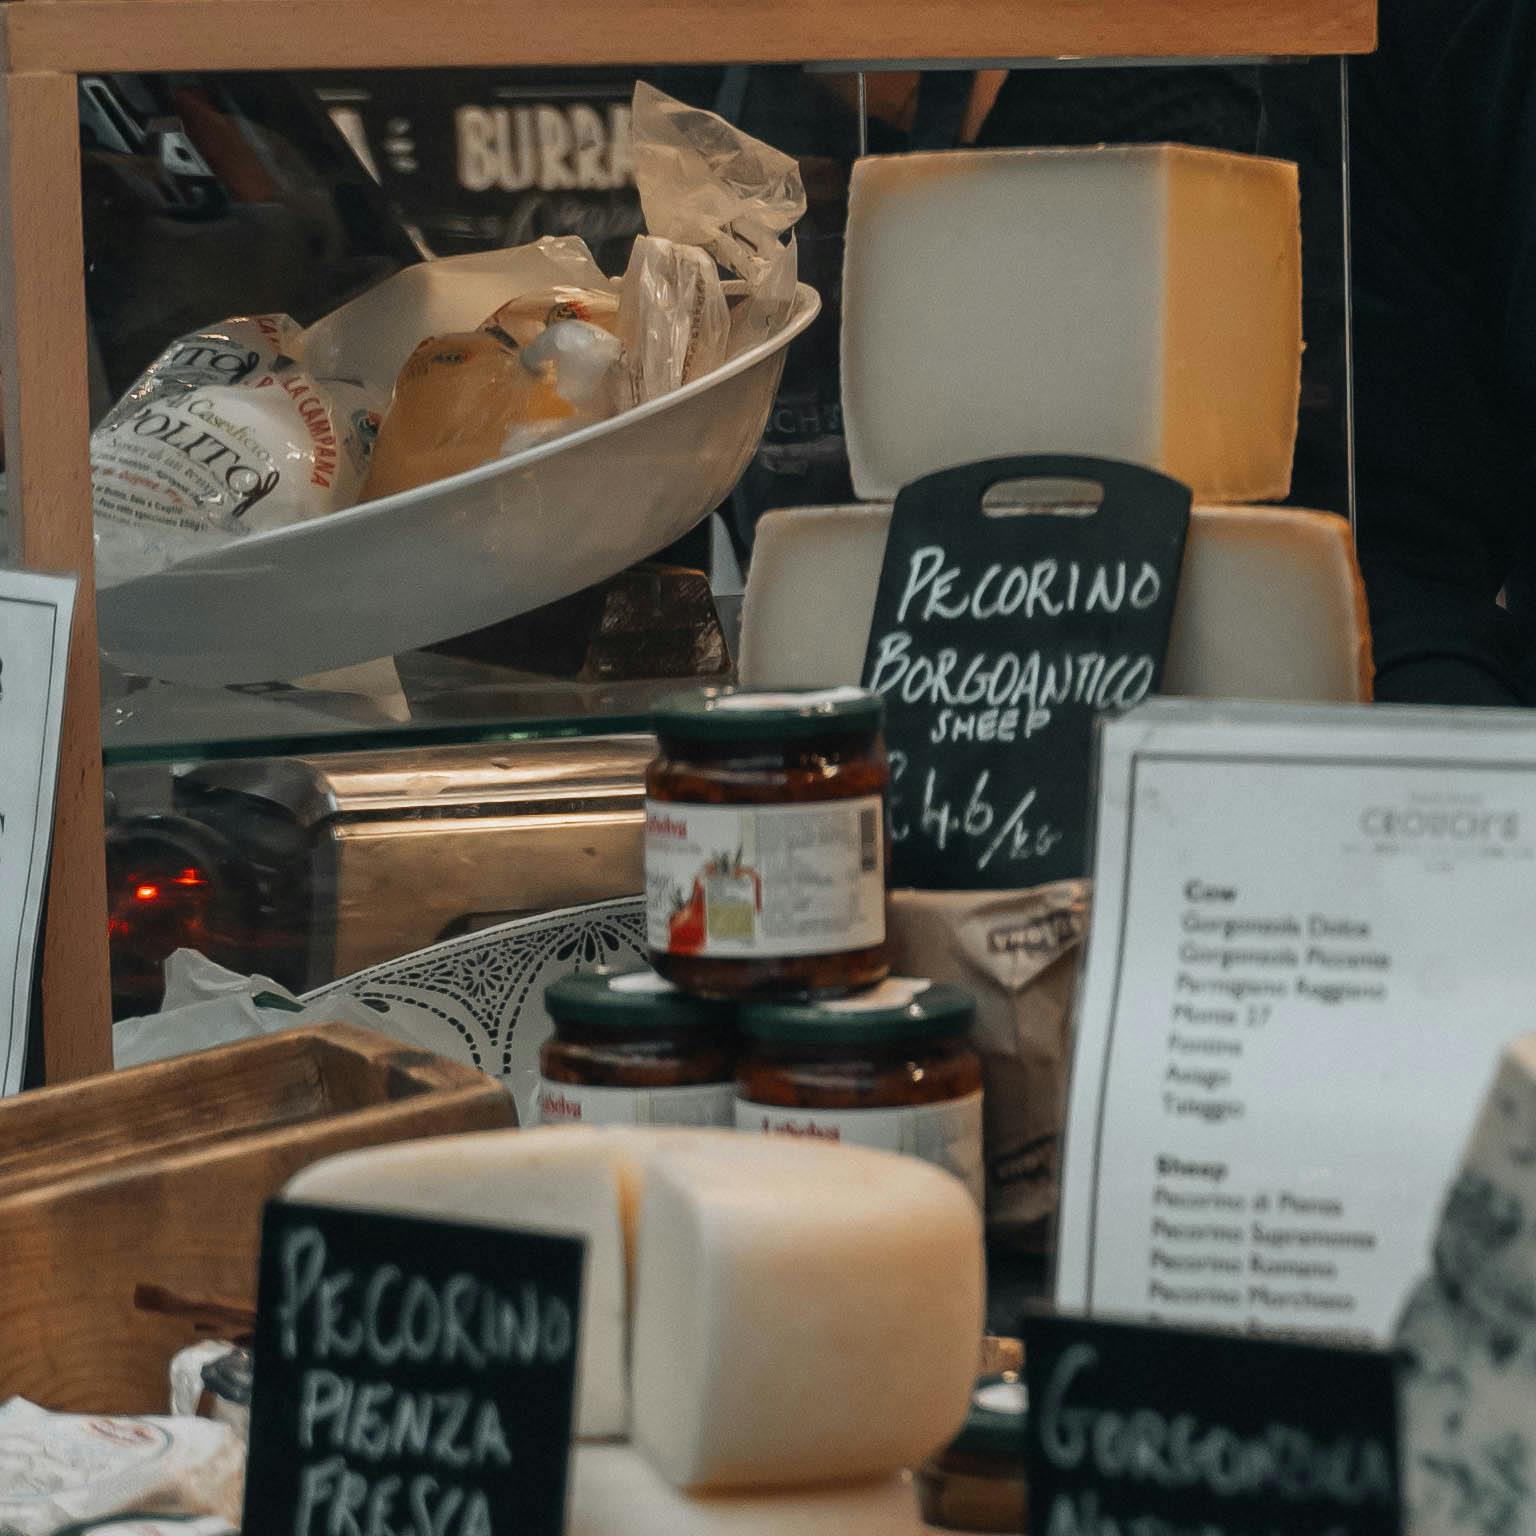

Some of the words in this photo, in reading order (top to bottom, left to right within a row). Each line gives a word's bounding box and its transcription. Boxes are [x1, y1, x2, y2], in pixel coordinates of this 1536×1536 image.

[898, 546, 1162, 620] PECORINO
[868, 631, 1156, 709] BORGOANTICO
[930, 708, 1052, 744] SHEEP
[277, 1225, 573, 1367] PECORINO
[299, 1367, 513, 1465] PIENZA
